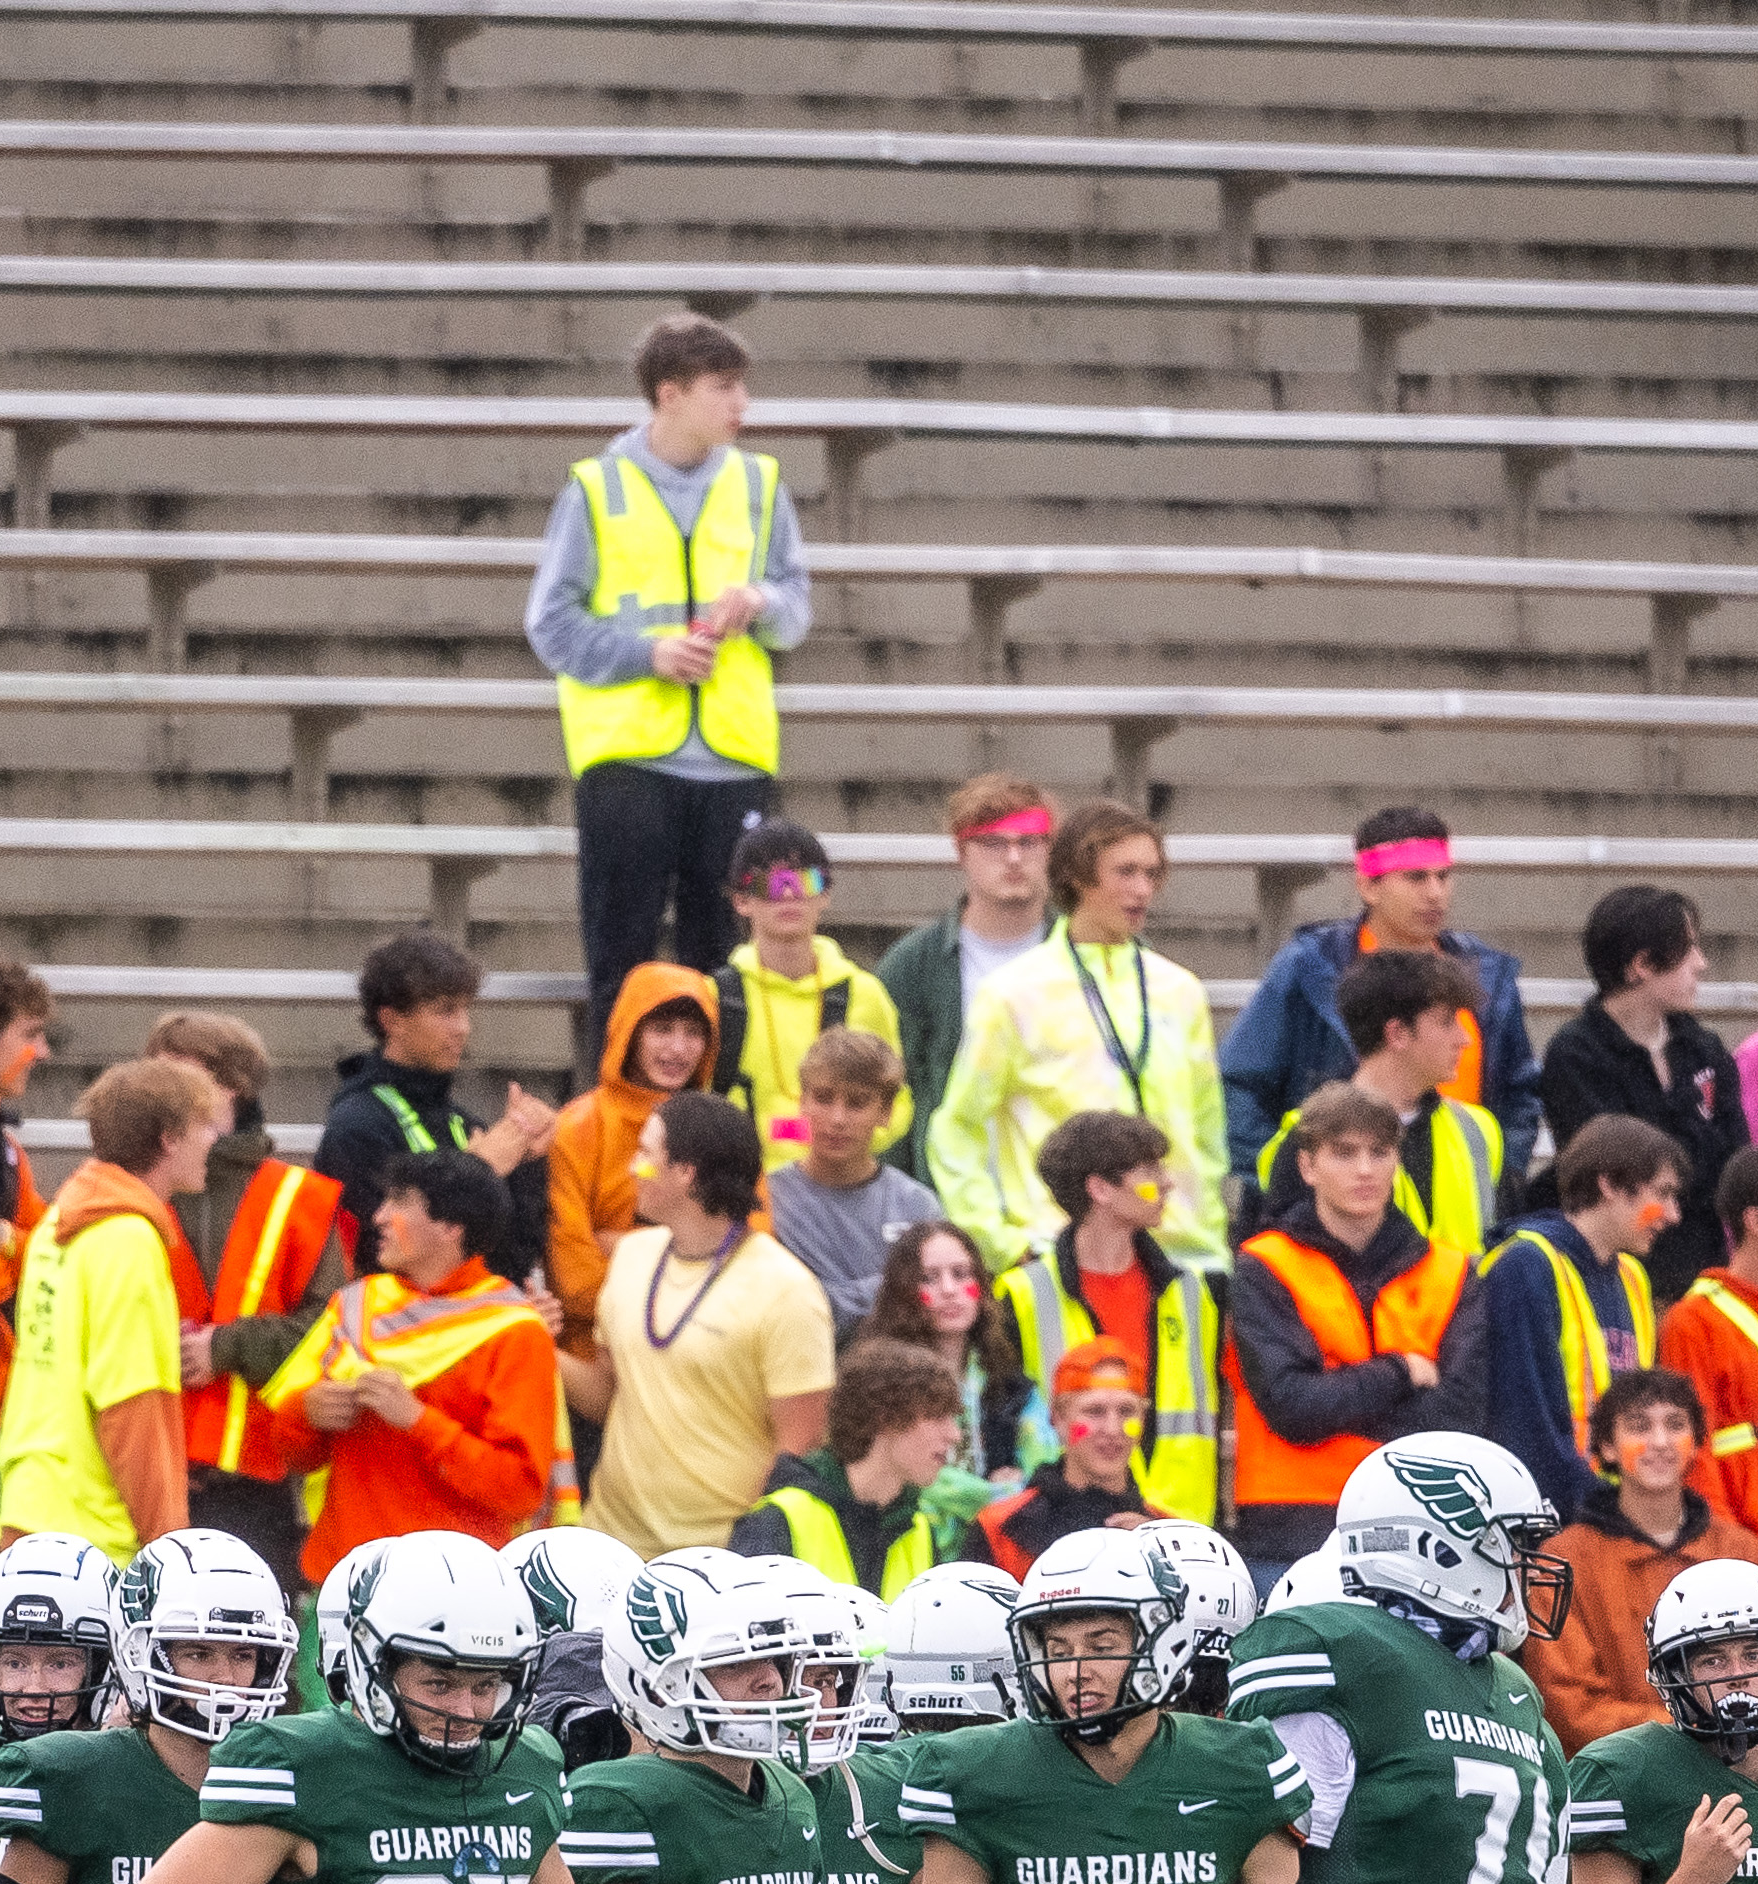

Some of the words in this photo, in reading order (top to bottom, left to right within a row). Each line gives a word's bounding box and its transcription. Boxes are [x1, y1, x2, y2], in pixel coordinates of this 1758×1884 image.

[18, 1608, 48, 1618] schutt
[1217, 1598, 1230, 1615] 27
[471, 1635, 504, 1647] VICIS
[950, 1665, 965, 1681] 55
[909, 1694, 964, 1709] schutt
[369, 1826, 533, 1862] GUARDIANS
